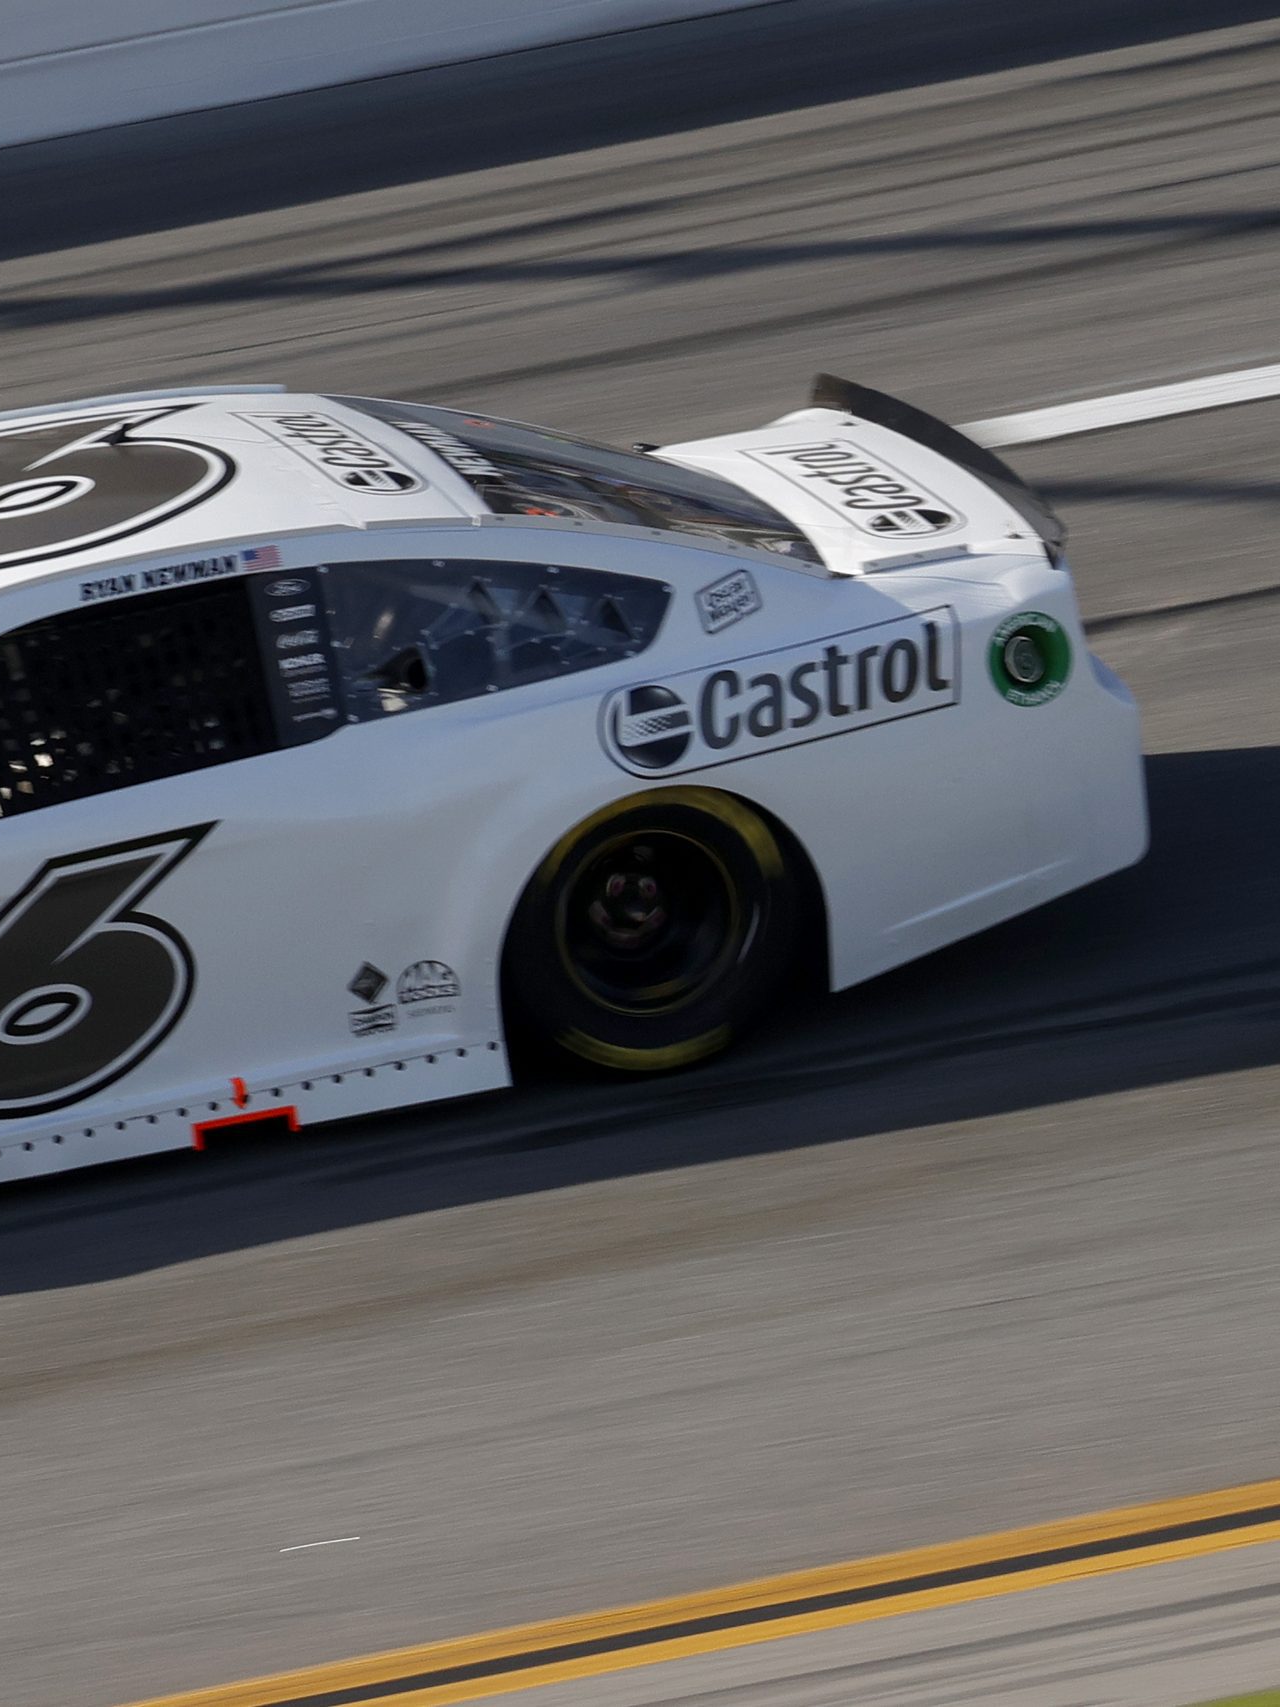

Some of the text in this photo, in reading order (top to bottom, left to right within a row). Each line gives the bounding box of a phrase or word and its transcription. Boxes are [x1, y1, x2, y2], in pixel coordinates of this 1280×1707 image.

[248, 413, 392, 469] Castrol
[764, 444, 924, 510] Castrol
[140, 554, 238, 589] NEWMAN
[699, 620, 952, 749] Castrol
